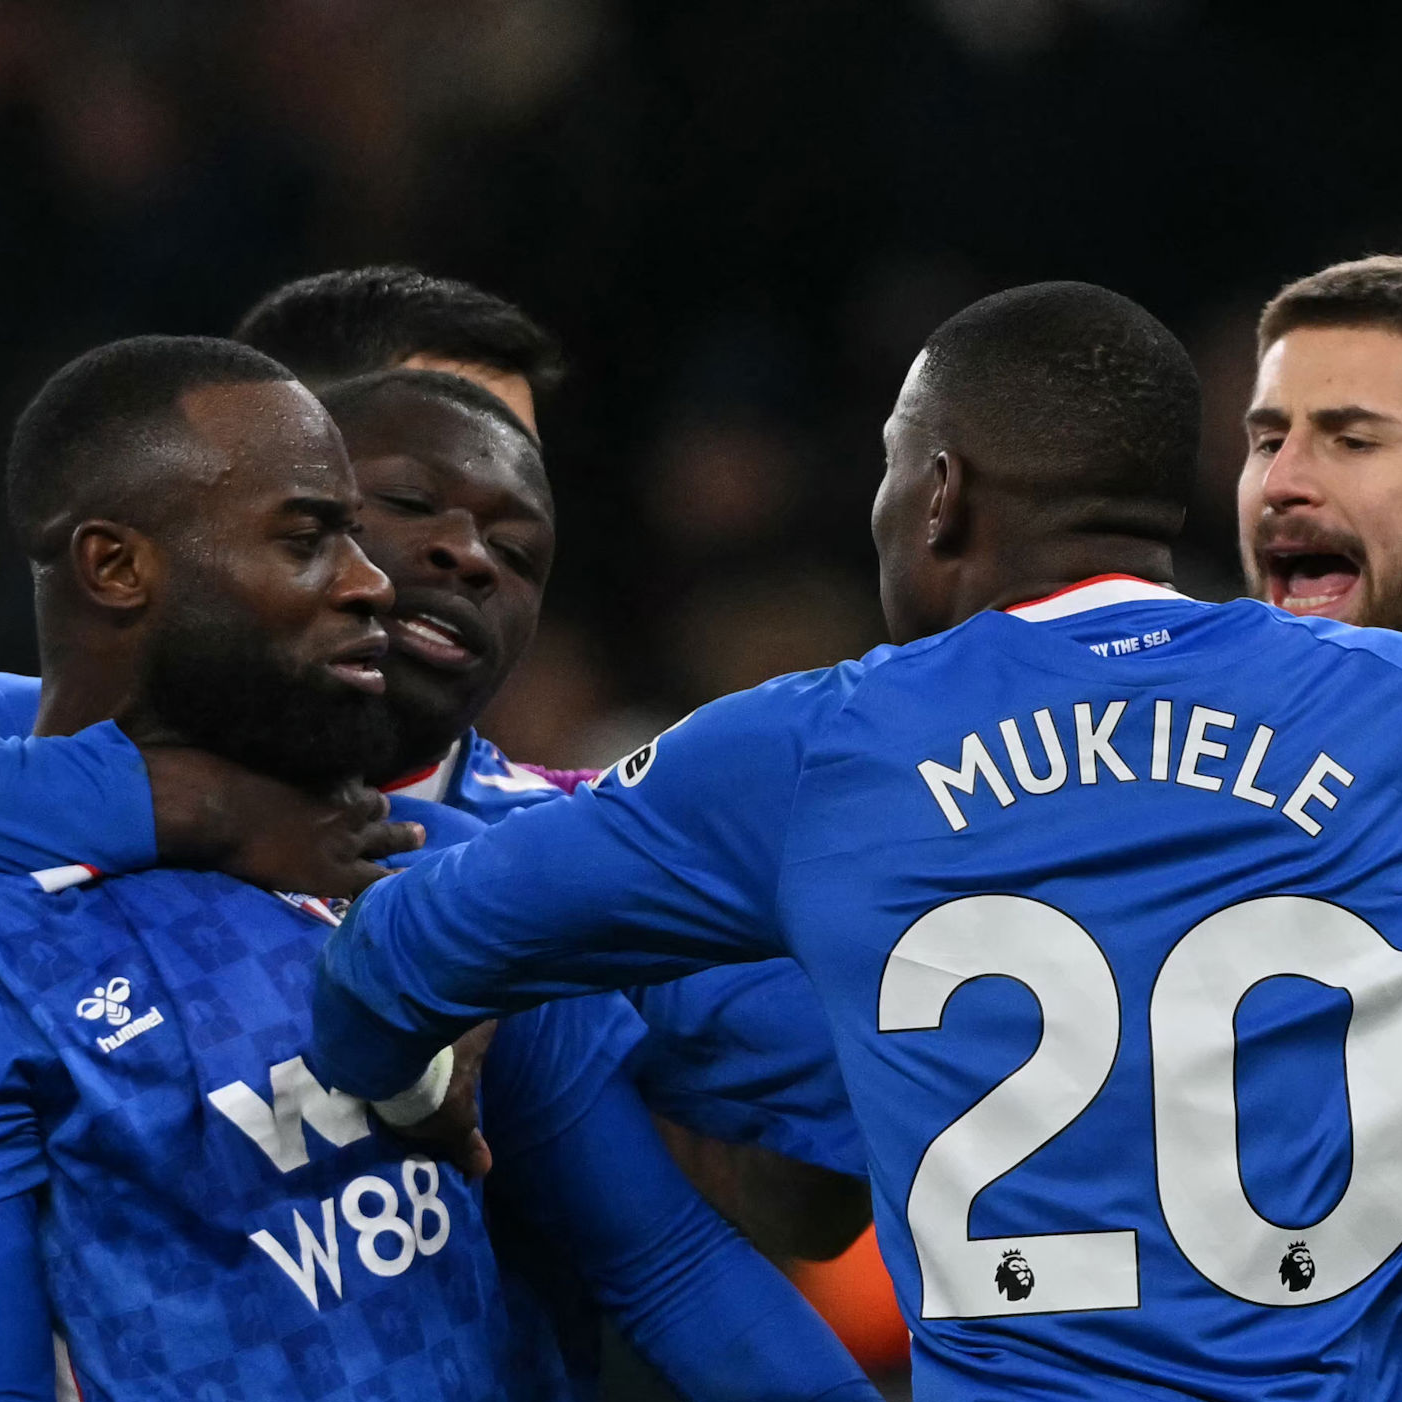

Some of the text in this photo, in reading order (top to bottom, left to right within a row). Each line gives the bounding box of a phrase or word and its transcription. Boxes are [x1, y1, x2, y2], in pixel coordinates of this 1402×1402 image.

[1111, 637, 1141, 656] THE
[1143, 629, 1172, 649] SEA
[917, 699, 1356, 838] MUKIELE
[96, 1006, 165, 1054] hummel
[249, 1154, 451, 1312] W88
